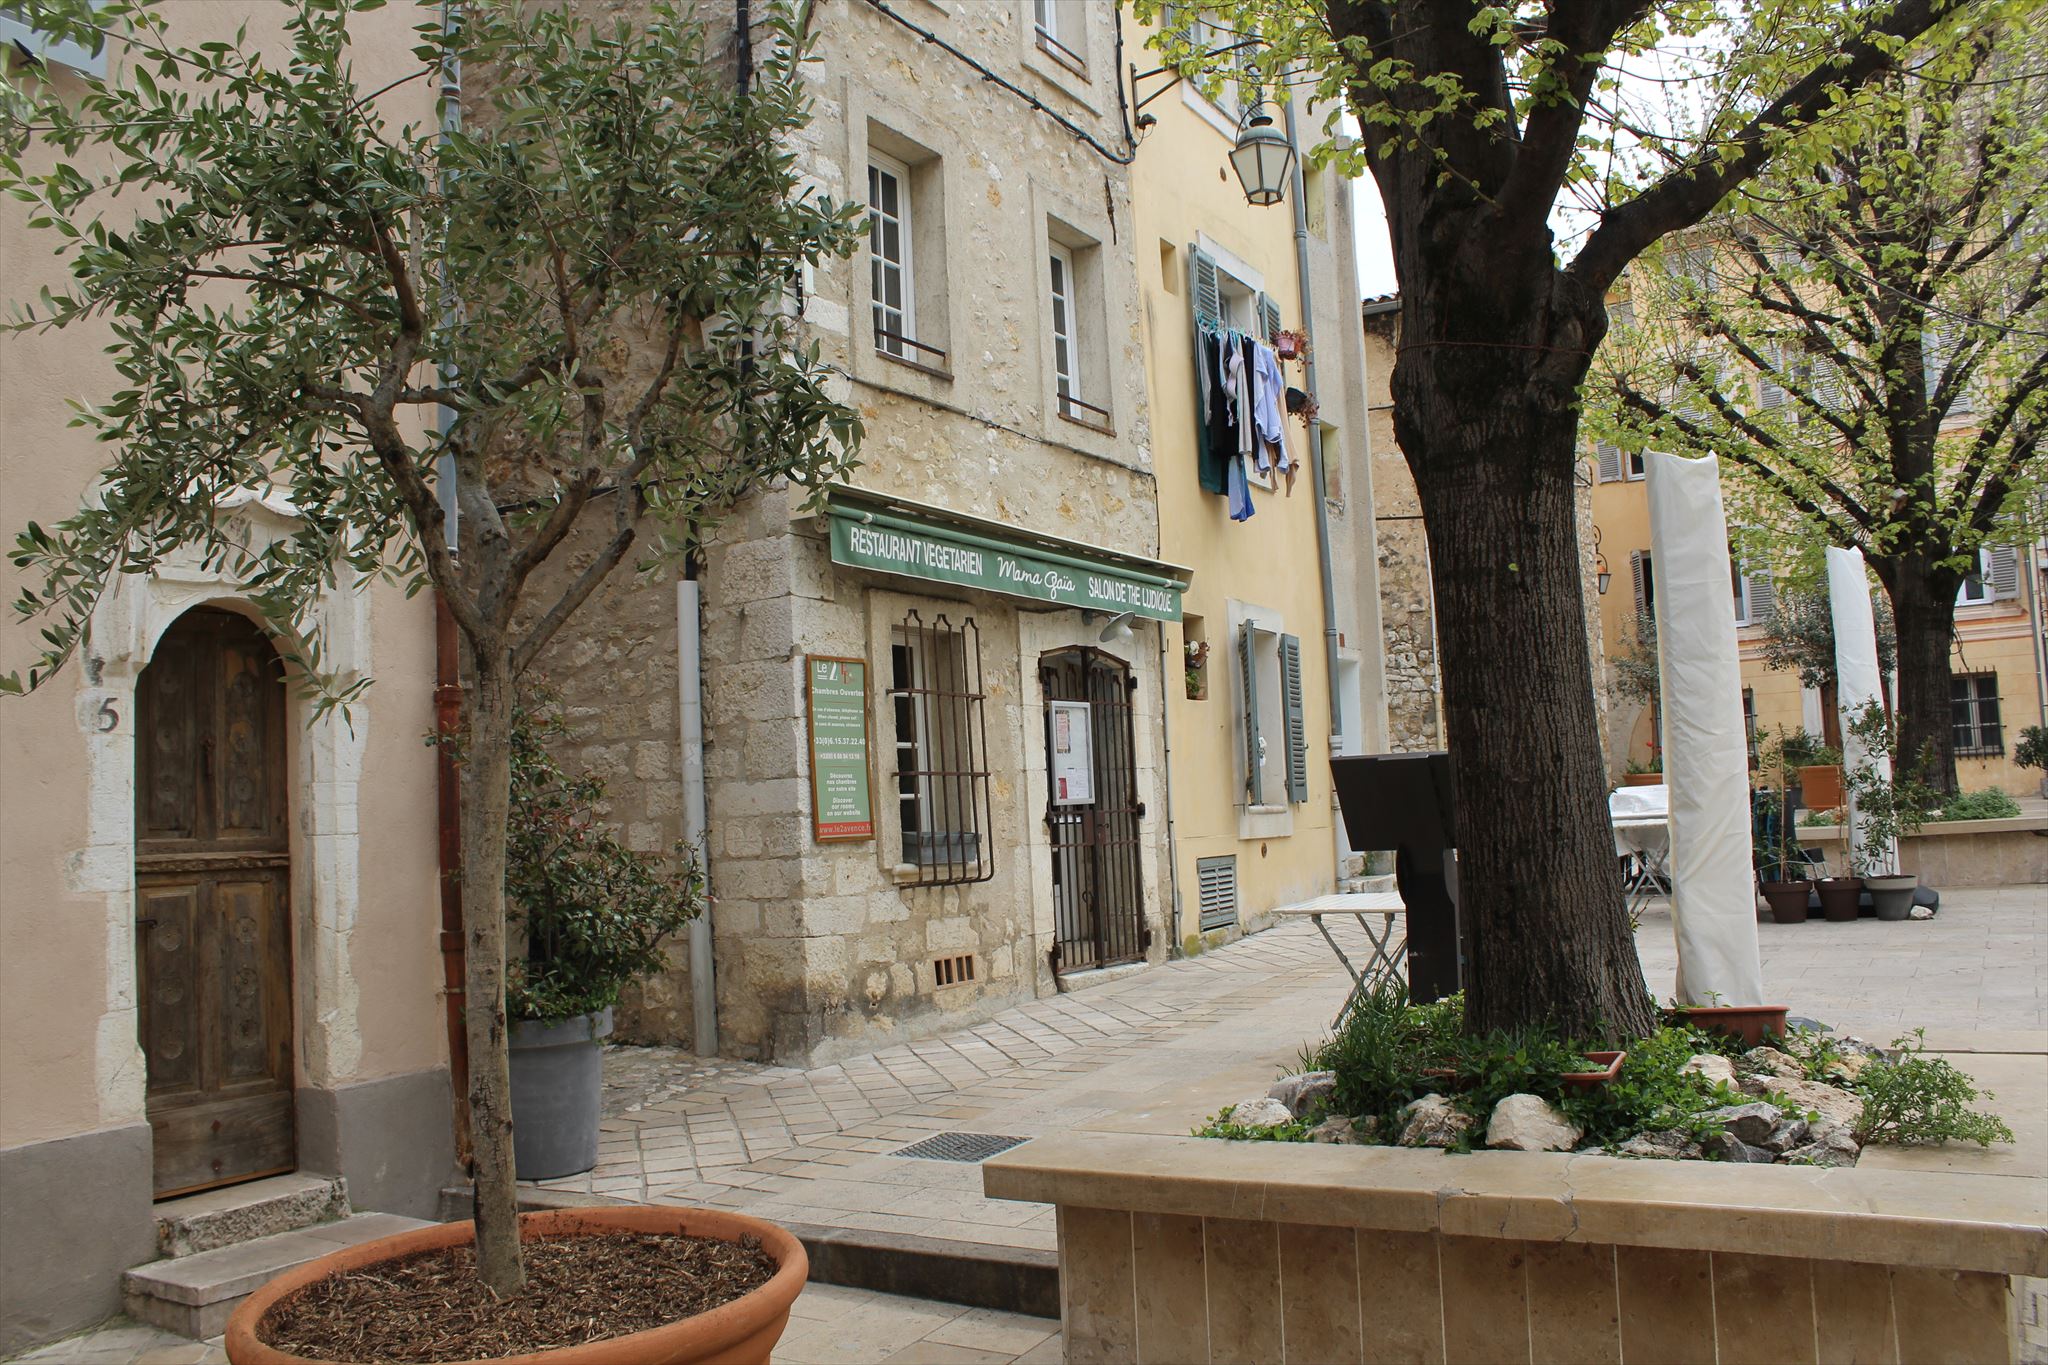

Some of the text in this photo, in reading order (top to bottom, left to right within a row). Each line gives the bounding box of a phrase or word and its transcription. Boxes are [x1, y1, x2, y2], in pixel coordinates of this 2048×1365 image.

[851, 527, 983, 576] RESTAURANT VEGETARIEN
[997, 556, 1076, 600] Mama Gaïa
[1088, 576, 1172, 612] SALON DE THE LUDIQUE
[816, 660, 827, 673] Le
[839, 688, 864, 697] Ouvertes
[97, 697, 119, 734] 5
